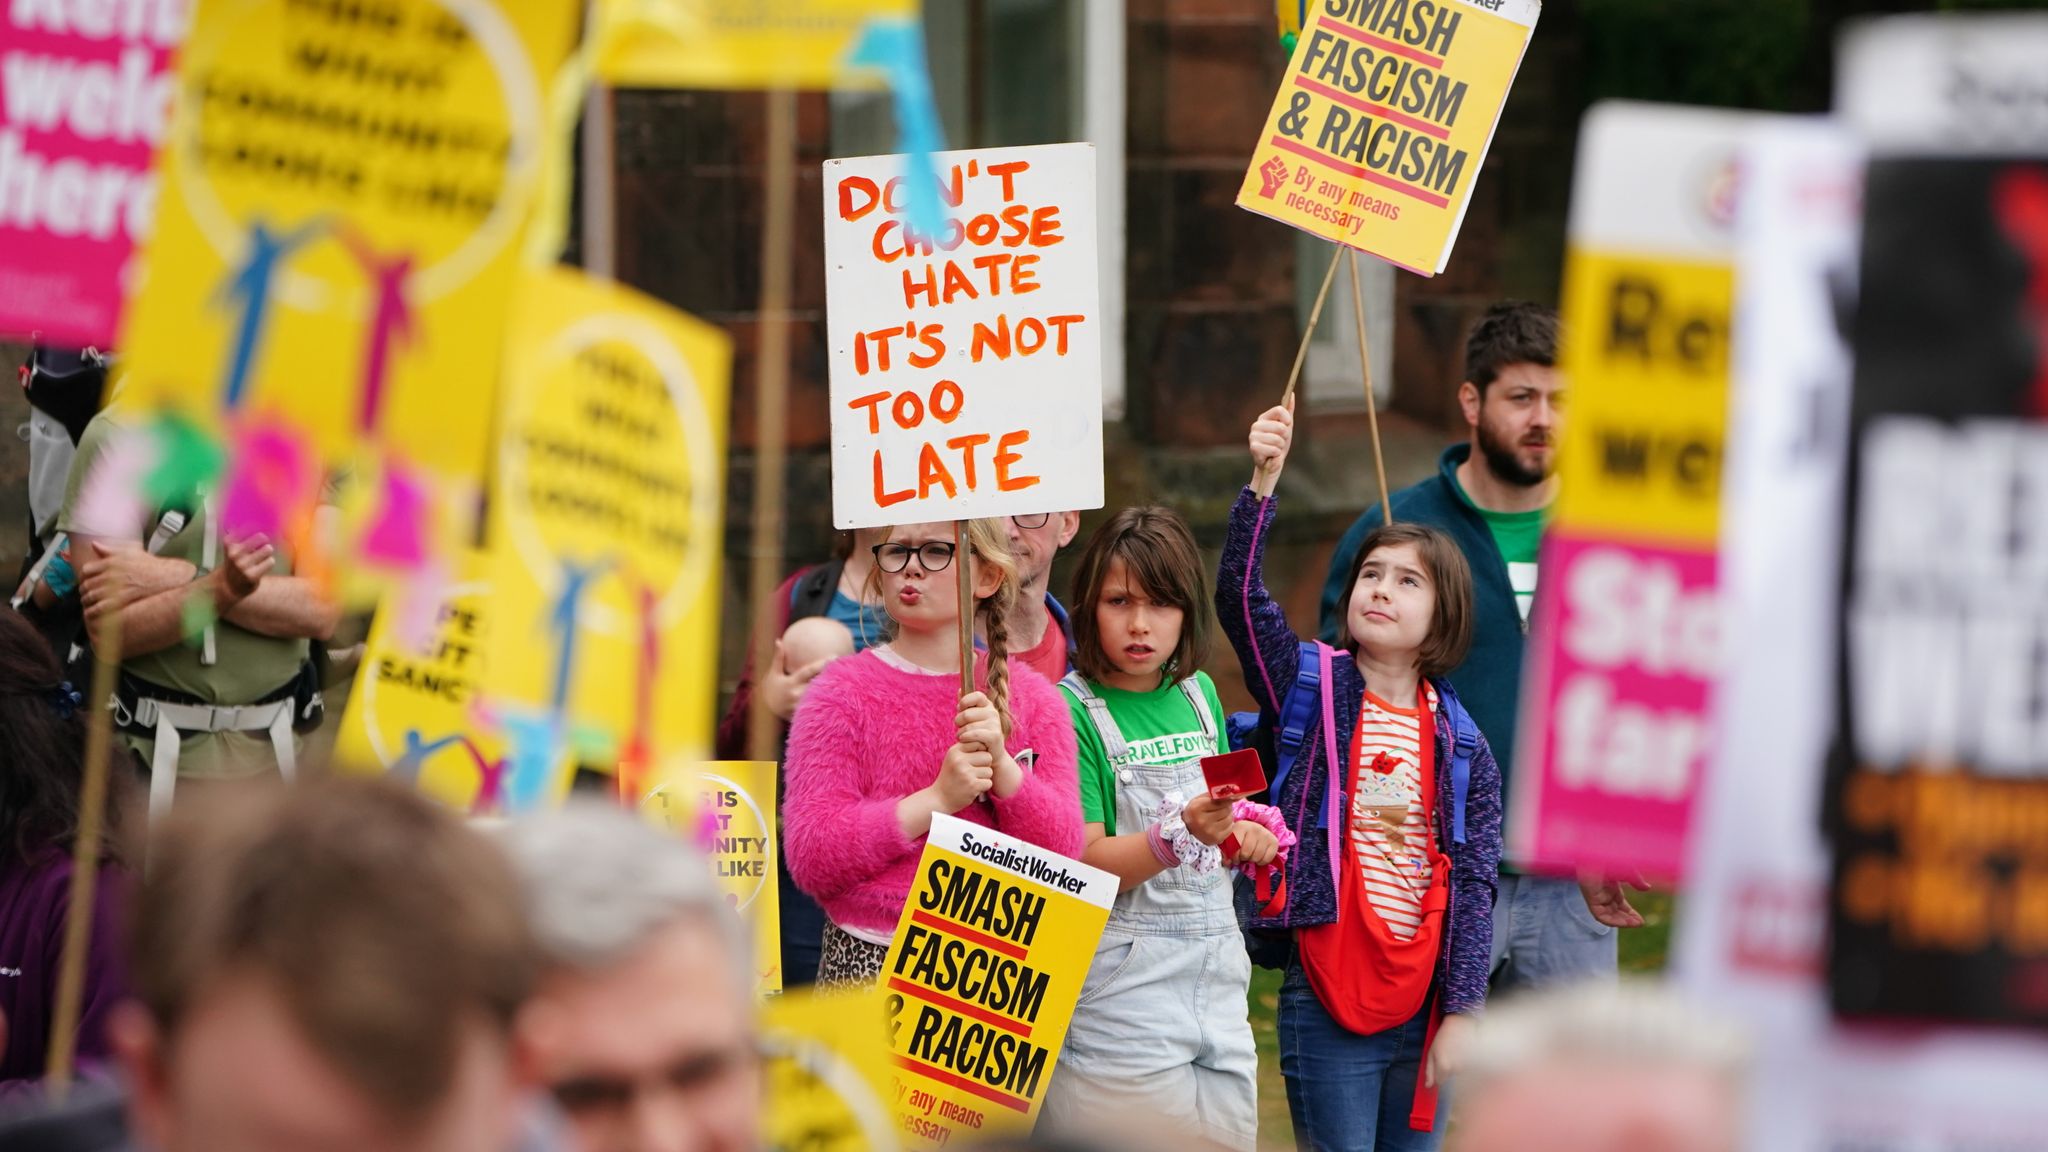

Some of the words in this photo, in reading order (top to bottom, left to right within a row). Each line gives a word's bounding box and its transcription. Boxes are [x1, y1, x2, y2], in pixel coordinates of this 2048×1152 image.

[1300, 29, 1468, 127] FASCISM
[1277, 91, 1312, 140] &
[1316, 104, 1468, 195] RACISM
[1285, 190, 1365, 235] necessary
[1294, 166, 1316, 191] By
[1318, 177, 1347, 205] any
[1349, 190, 1400, 221] means
[872, 204, 1064, 263] CHOOSE
[903, 253, 1041, 309] HATE
[854, 321, 946, 375] IT'S
[971, 314, 1085, 363] NOT
[848, 380, 964, 434] TOO
[873, 430, 1041, 508] LATE
[716, 791, 738, 808] IS
[716, 860, 765, 877] LIKE
[919, 859, 1047, 946] SMASH
[893, 924, 1050, 1023] FASCISM
[908, 1004, 1049, 1099] RACISM
[909, 1089, 938, 1116] any
[938, 1099, 984, 1129] means
